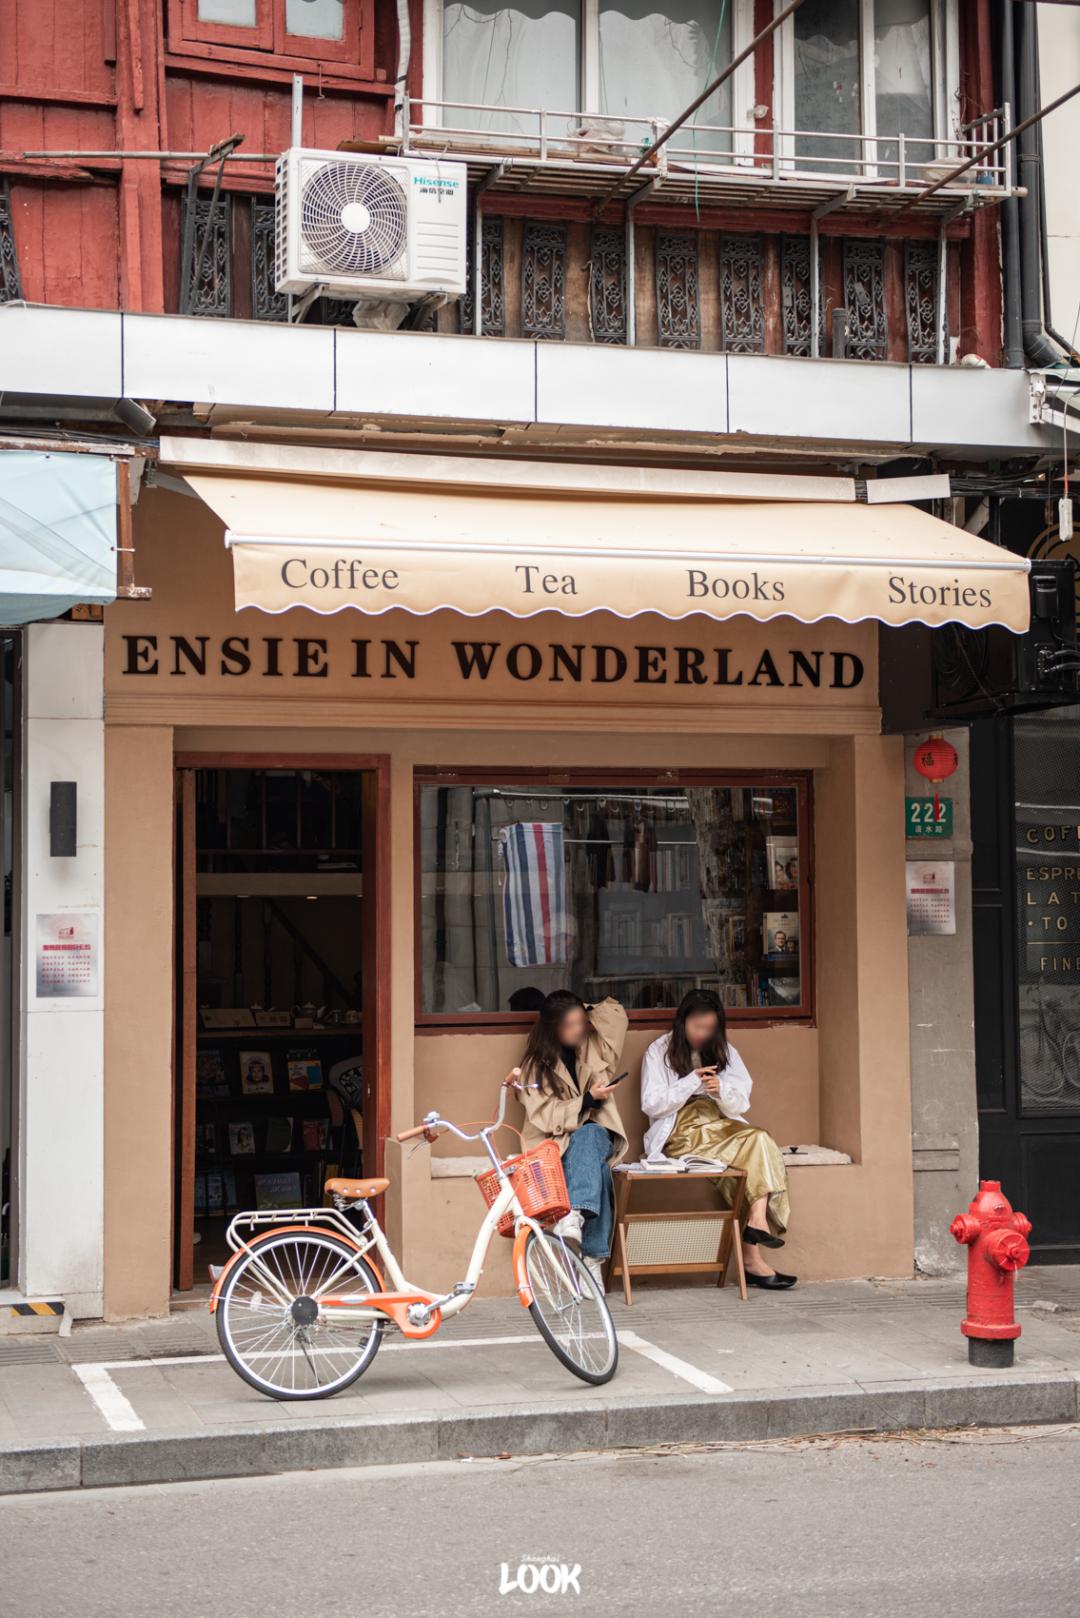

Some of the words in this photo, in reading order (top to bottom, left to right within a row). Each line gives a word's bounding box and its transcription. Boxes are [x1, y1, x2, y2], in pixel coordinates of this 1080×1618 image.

[413, 176, 461, 187] Hisense
[281, 559, 400, 590] Coffee
[515, 565, 578, 595] Tea
[685, 569, 785, 601] Books
[888, 576, 992, 608] Stories
[122, 635, 329, 677] ENSIE
[351, 639, 420, 678] IN
[451, 641, 865, 689] WONDERLAND
[911, 803, 947, 823] 222
[1026, 825, 1080, 843] COF
[1041, 916, 1068, 930] TO
